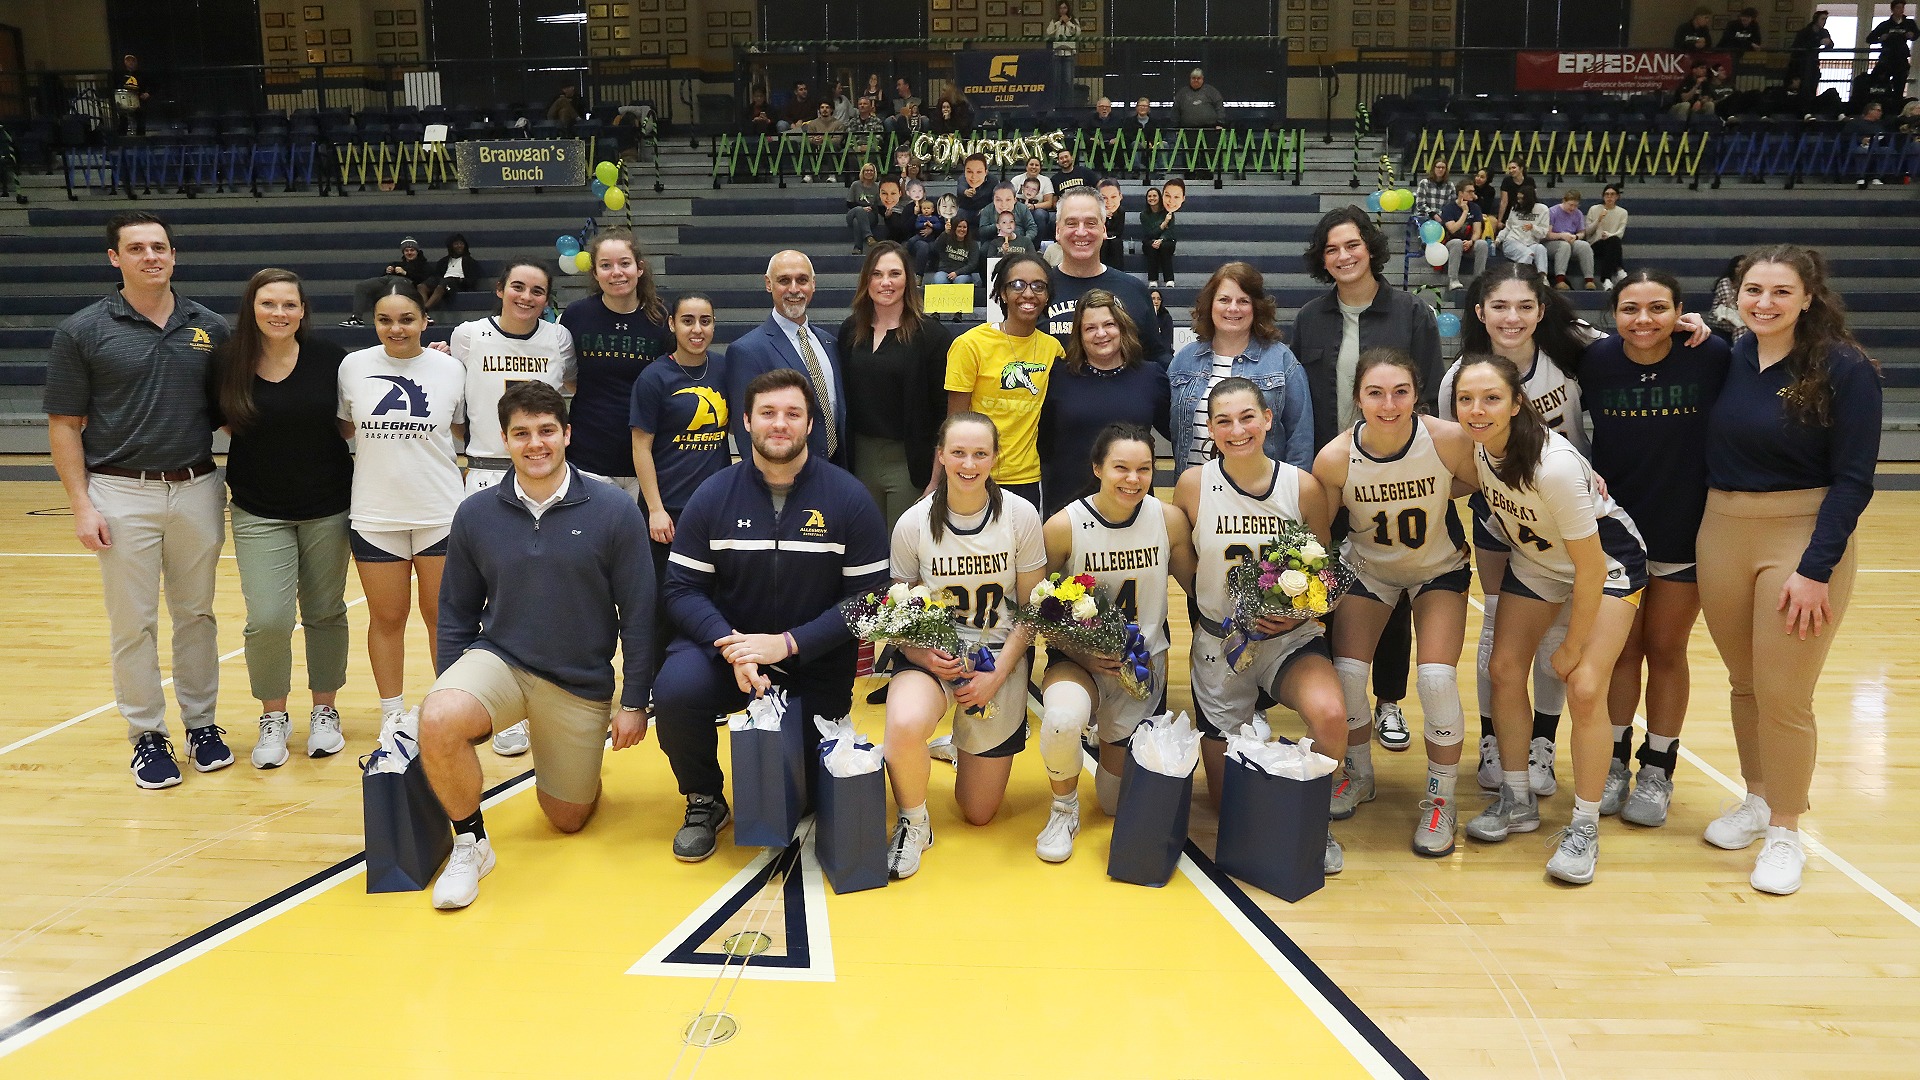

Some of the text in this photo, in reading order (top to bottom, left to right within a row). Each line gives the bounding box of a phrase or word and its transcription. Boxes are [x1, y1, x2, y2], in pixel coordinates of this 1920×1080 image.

[1558, 53, 1685, 74] ERIEBANK
[964, 84, 1045, 93] GOLDEN GATOR
[480, 145, 565, 162] Branygan's
[914, 131, 1065, 167] CONGRATS
[502, 166, 544, 180] Bunch
[483, 356, 549, 373] ALLEGHENY
[1603, 407, 1697, 417] BASKETBALL
[361, 421, 437, 432] ALLEGHENY
[672, 431, 725, 443] ALLEGHEN
[1354, 476, 1436, 502] ALLEGHENY
[1216, 515, 1287, 534] ALLEGHEN
[1372, 507, 1427, 549] 10
[932, 552, 1008, 576] ALLEGHENY
[1084, 546, 1159, 572] ALLEGHENY
